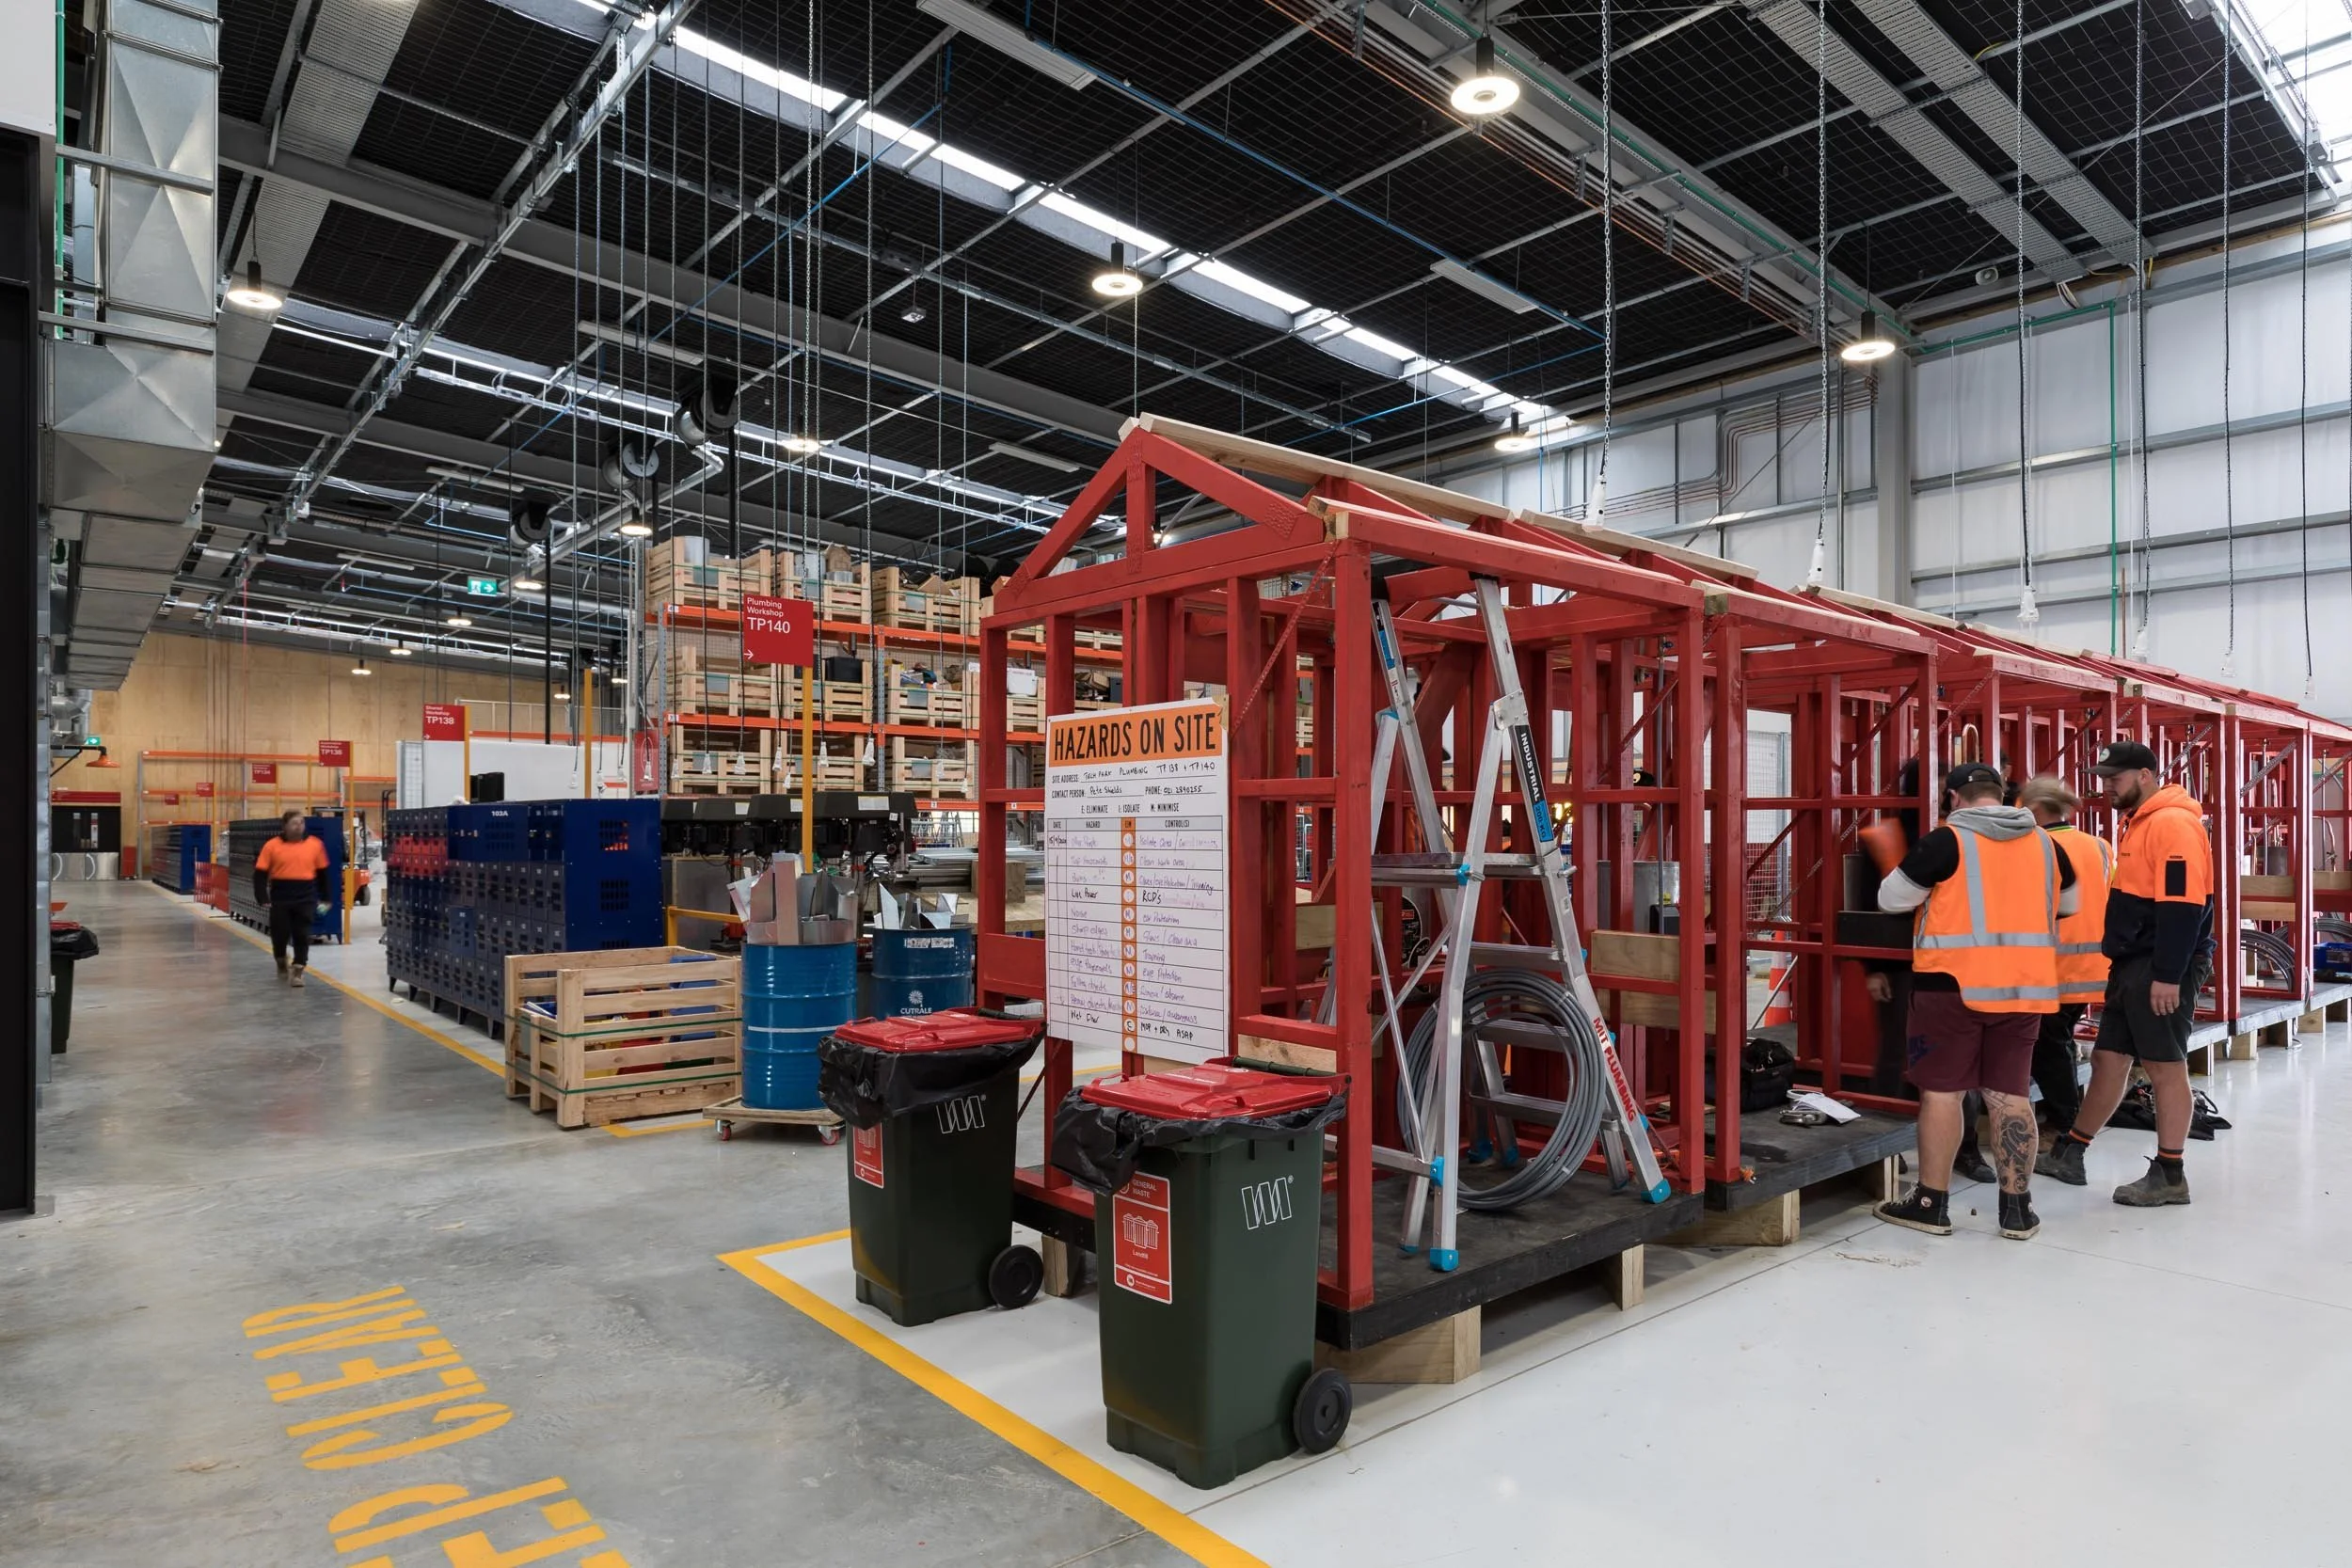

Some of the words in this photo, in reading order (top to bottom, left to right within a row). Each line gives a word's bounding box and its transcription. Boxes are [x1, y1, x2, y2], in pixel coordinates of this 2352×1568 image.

[747, 597, 782, 610] Plumbing
[747, 607, 784, 617] Workshop
[747, 617, 790, 633] TP140
[426, 716, 454, 724] TP138
[1055, 721, 1132, 760] HAZARDS
[1140, 718, 1165, 754] ON
[1174, 712, 1216, 752] SITE
[1120, 767, 1148, 776] PLUMBING
[1520, 733, 1540, 801] INDUSTRIAL
[1052, 775, 1060, 784] SITE
[1052, 790, 1069, 799] CONTACT
[1087, 805, 1108, 814] ELIMINATE
[1123, 804, 1140, 813] ISOLATE
[1157, 802, 1179, 812] MINIMISE
[1086, 820, 1101, 829] HAZARD
[1539, 824, 1546, 838] KG
[1142, 888, 1161, 904] RCD's
[1176, 1028, 1193, 1040] ASAP
[1594, 1017, 1608, 1044] MIT
[1604, 1048, 1637, 1122] PLUMBING
[1132, 1180, 1157, 1191] GENERAL
[1133, 1188, 1151, 1197] WASTE
[242, 1285, 514, 1470] CLEAR
